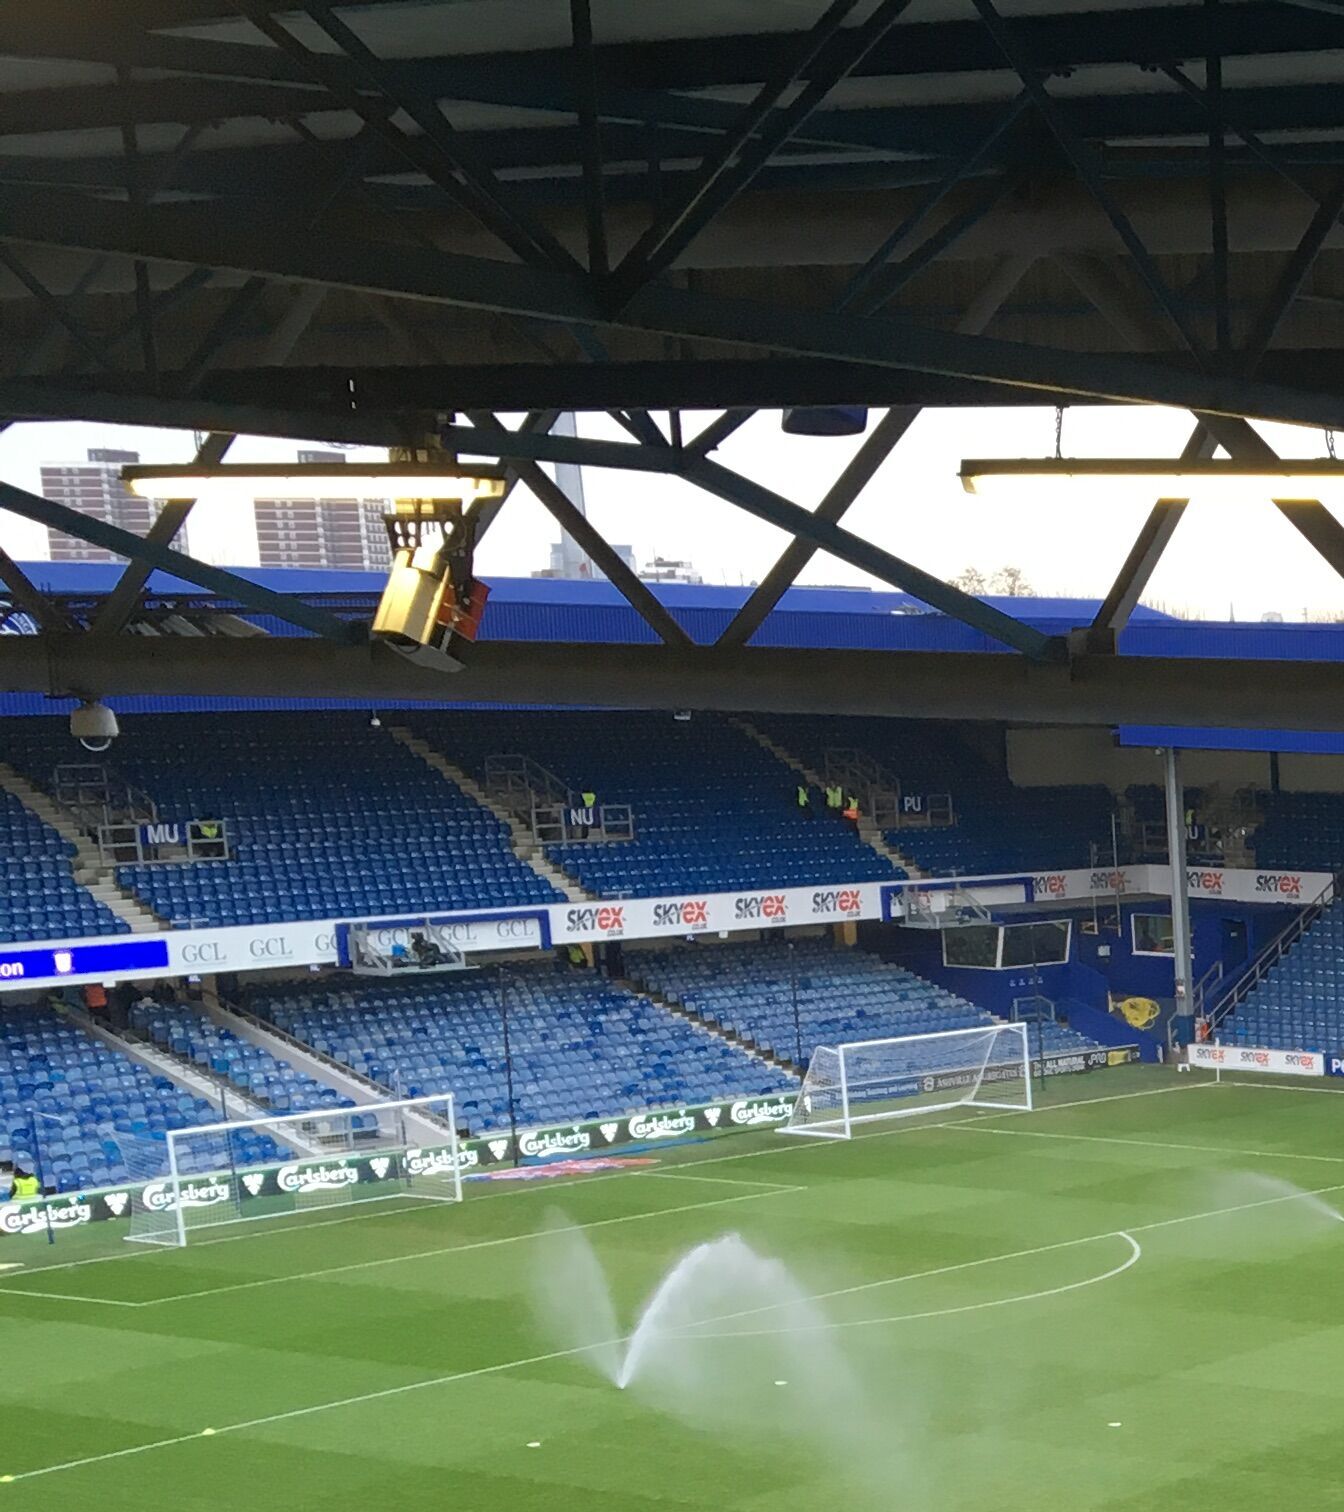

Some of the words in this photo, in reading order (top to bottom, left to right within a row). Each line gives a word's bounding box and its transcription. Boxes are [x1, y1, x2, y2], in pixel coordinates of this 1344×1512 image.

[904, 796, 921, 811] PU
[571, 808, 594, 825] NU
[147, 824, 179, 843] MU
[497, 918, 534, 938] GCL
[182, 942, 227, 963] GCL
[250, 937, 293, 958] GCL
[730, 1099, 793, 1124] Carlsberg
[629, 1113, 695, 1139] Carlsberg
[519, 1130, 590, 1157] Carlsberg
[277, 1164, 358, 1193] Carlsberg
[143, 1182, 229, 1212] Carsberg
